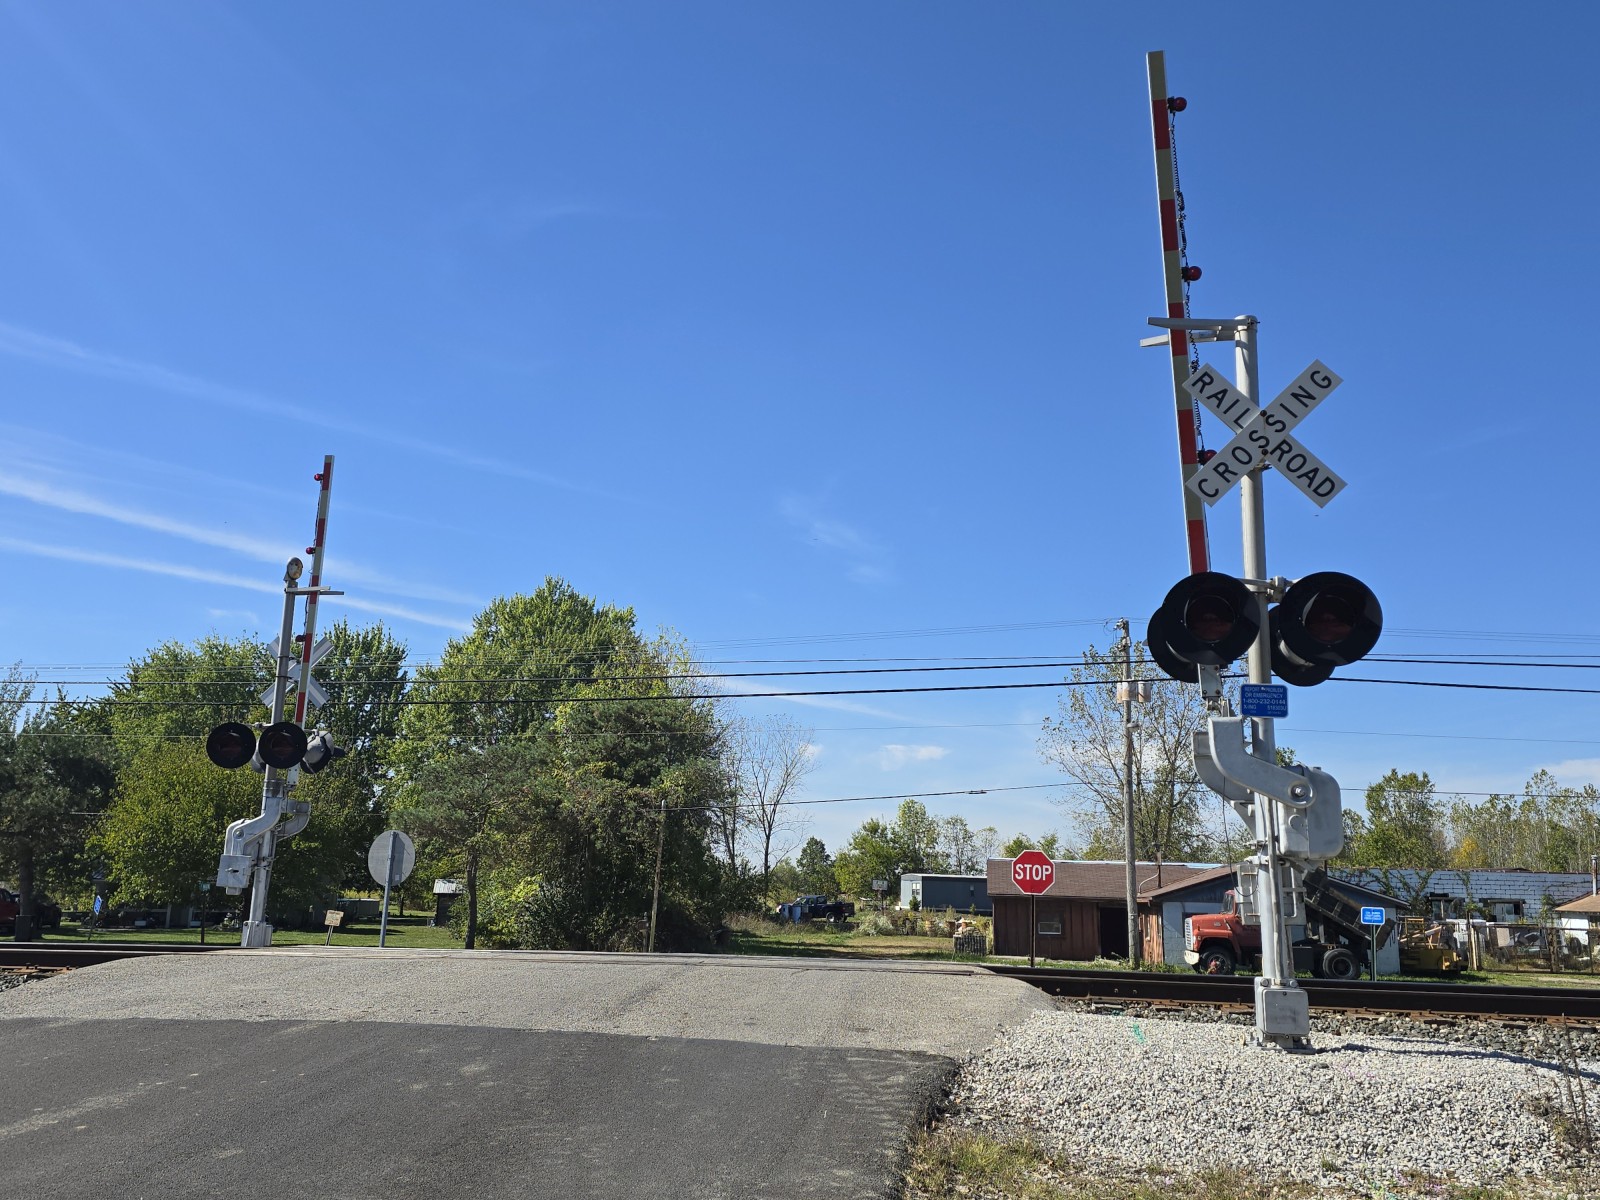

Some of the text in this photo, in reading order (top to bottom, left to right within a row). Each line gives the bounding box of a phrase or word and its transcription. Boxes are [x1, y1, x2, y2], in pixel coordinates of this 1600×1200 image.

[1192, 371, 1335, 497] RAIL ROAD
[1198, 370, 1332, 498] CROSSING
[1015, 864, 1051, 881] STOP
